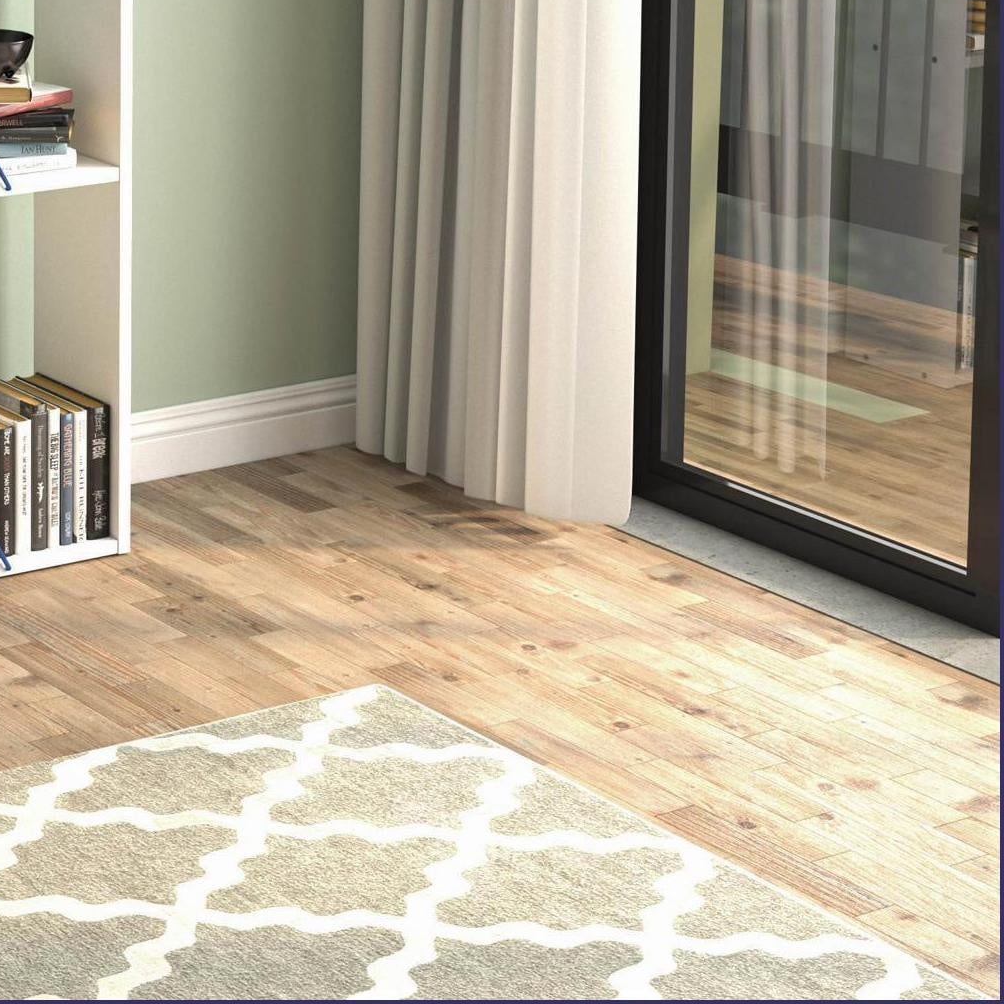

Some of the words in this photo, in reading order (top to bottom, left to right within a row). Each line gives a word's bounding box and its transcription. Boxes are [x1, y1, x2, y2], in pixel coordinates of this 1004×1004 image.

[63, 423, 72, 466] GATHERING
[50, 454, 58, 470] SLEEP
[63, 468, 72, 487] BLUE
